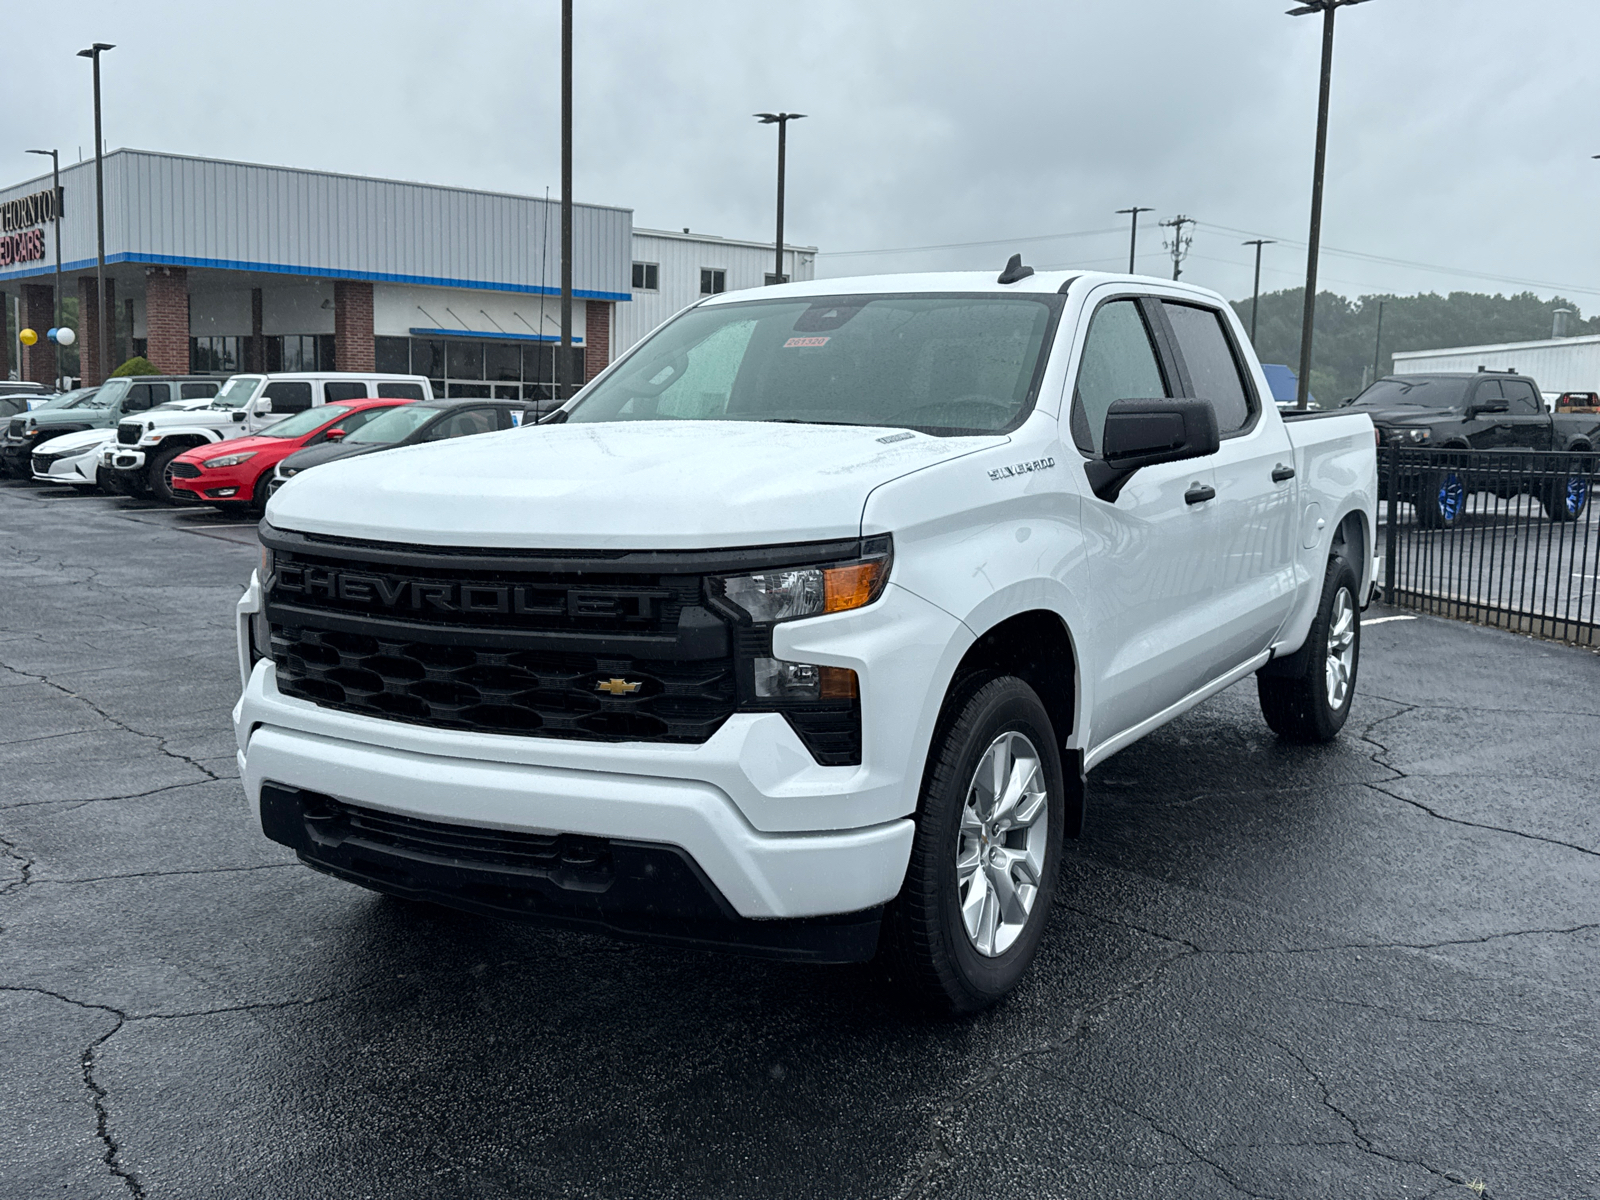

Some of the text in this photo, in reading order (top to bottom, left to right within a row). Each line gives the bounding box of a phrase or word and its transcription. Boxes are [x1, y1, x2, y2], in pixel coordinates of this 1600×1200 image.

[14, 228, 43, 262] CARS
[987, 457, 1055, 481] SILVERADO
[275, 567, 673, 618] CHEVROLET
